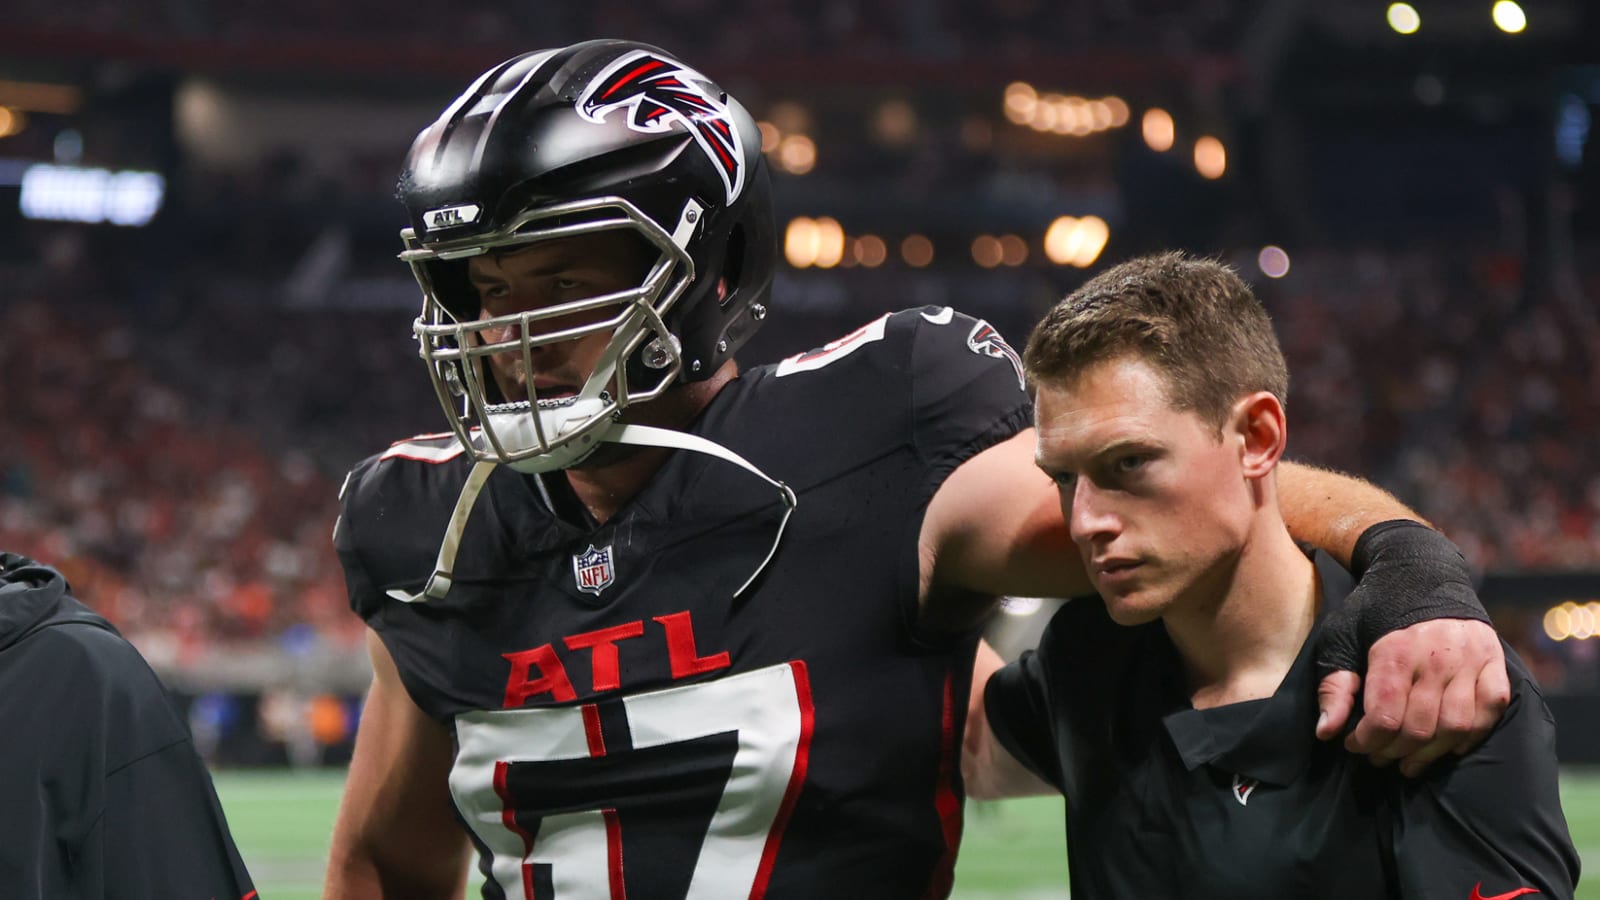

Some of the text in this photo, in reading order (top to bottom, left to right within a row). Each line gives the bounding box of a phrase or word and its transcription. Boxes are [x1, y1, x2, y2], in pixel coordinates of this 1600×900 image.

[434, 209, 464, 225] ATL
[581, 566, 609, 586] NFL
[501, 610, 731, 708] ATL
